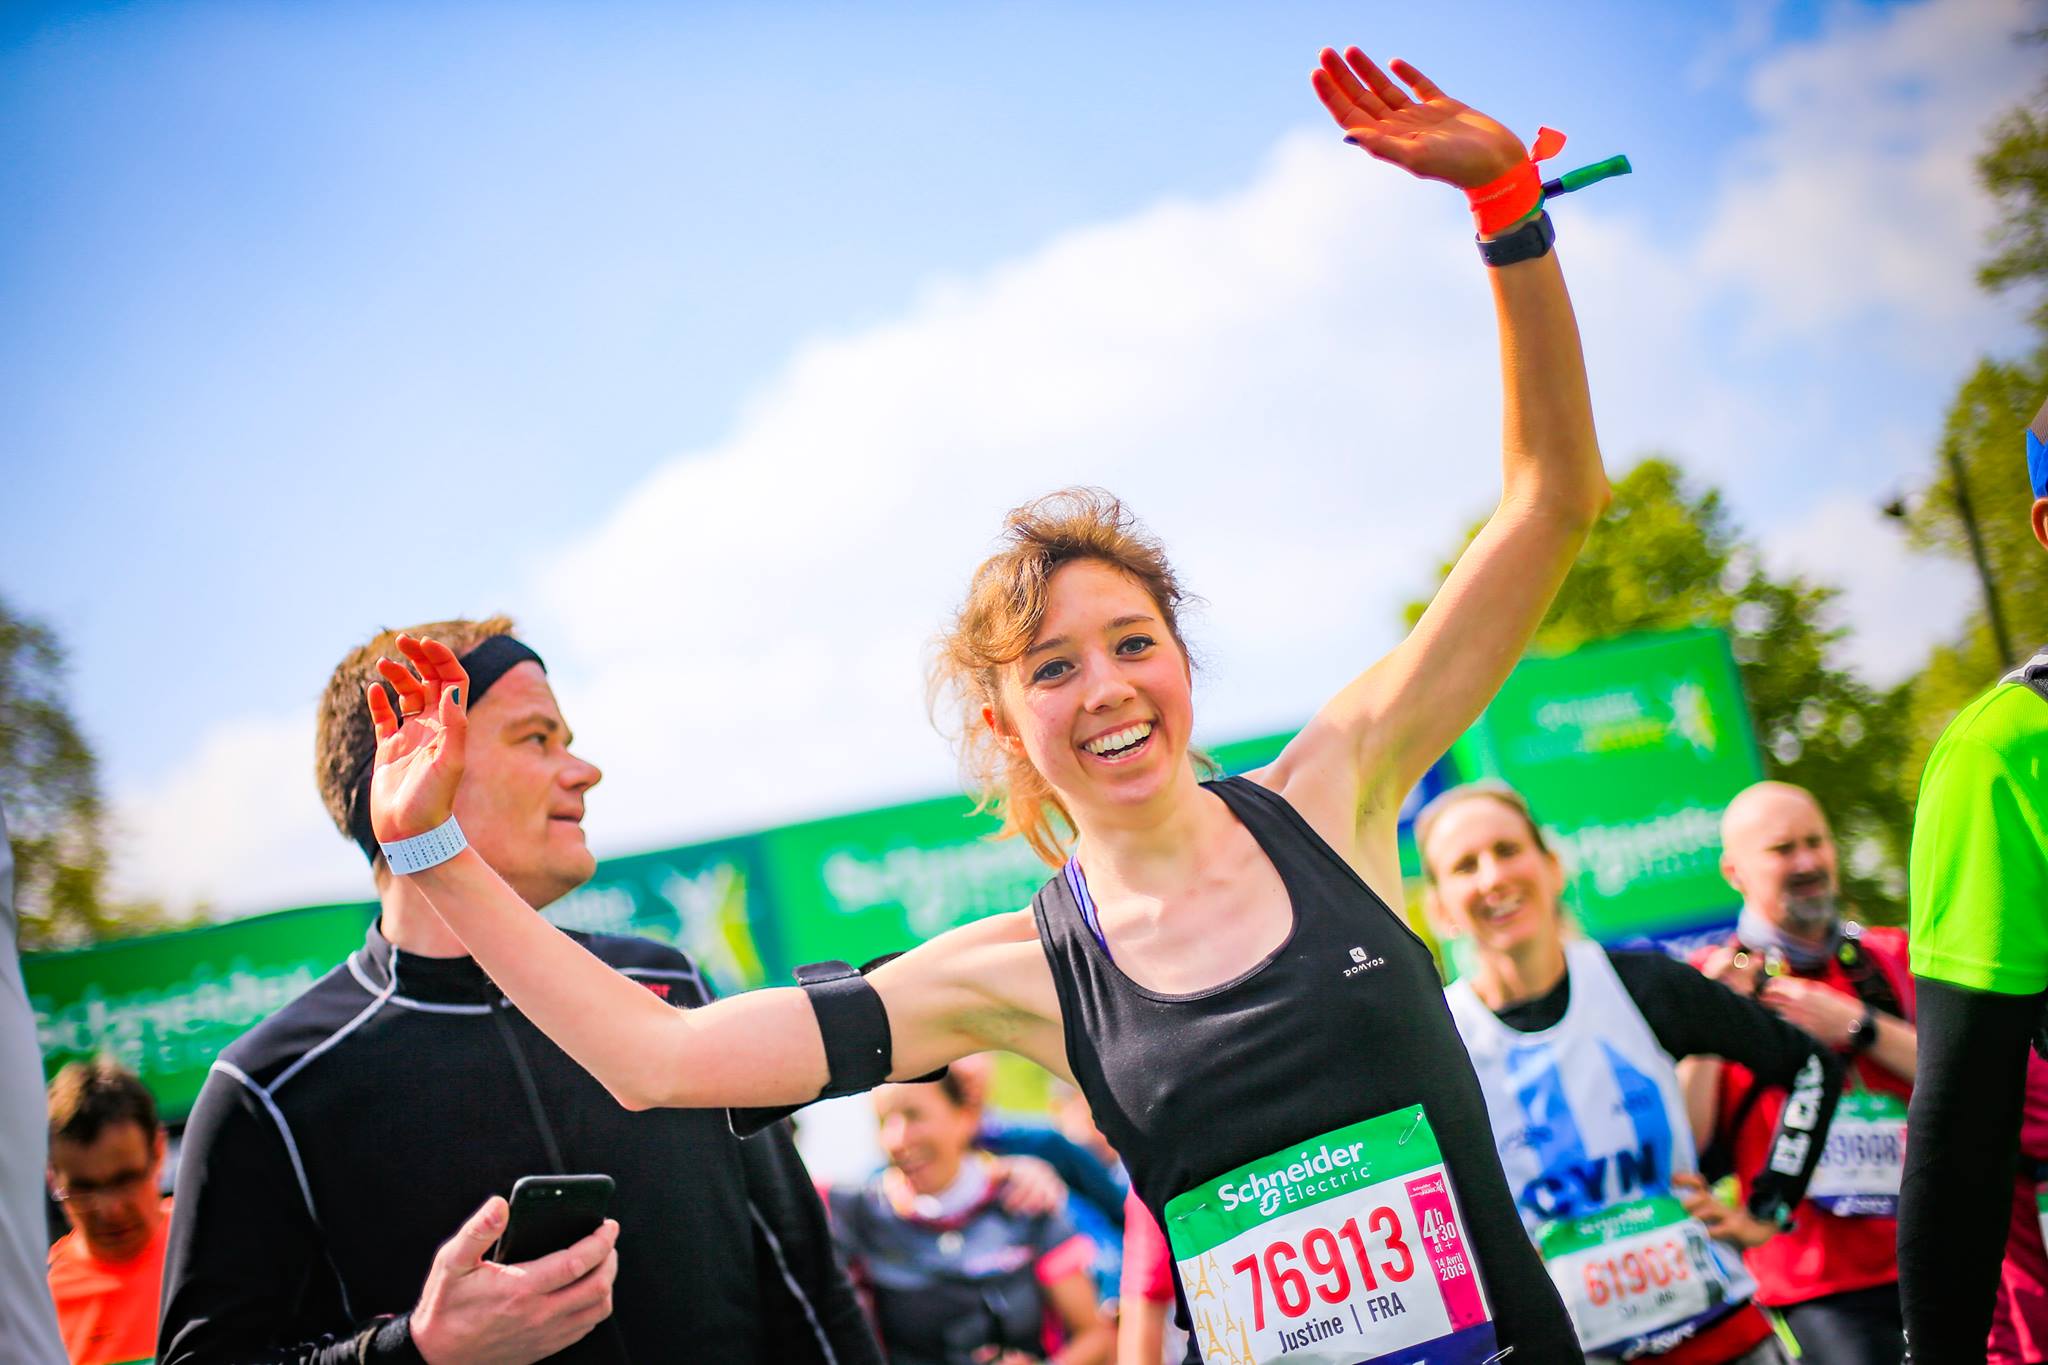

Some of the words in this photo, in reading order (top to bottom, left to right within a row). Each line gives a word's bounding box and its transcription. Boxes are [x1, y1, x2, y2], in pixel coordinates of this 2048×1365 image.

[1343, 957, 1384, 977] DOMYOS
[1218, 1142, 1364, 1212] Schneider
[1285, 1166, 1370, 1203] Electric
[1232, 1206, 1415, 1332] 76913
[1435, 1257, 1445, 1269] 14
[1446, 1252, 1463, 1267] Avril
[1440, 1263, 1467, 1281] 2019
[1583, 1240, 1689, 1308] 61903
[1278, 1316, 1345, 1354] Justine
[1367, 1292, 1407, 1322] FRA
